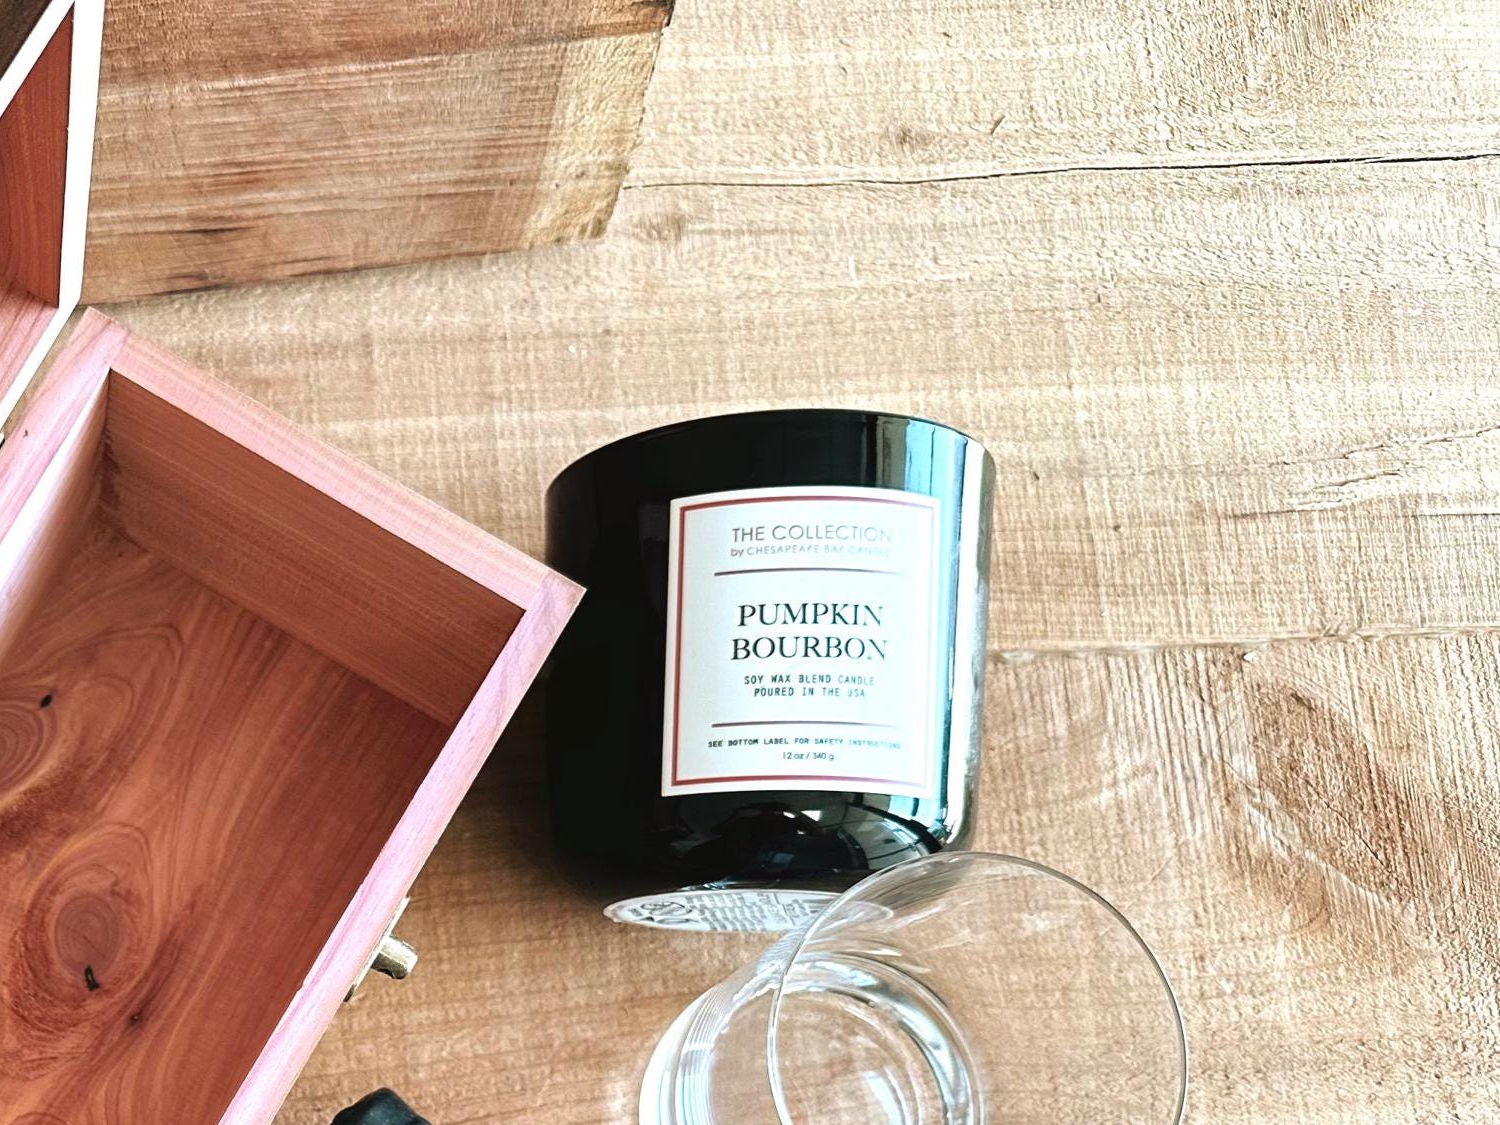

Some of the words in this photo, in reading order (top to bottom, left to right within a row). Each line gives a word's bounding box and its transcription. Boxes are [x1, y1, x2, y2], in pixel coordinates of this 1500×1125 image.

[732, 526, 765, 543] THE
[771, 524, 892, 542] COLLECTION
[730, 547, 744, 558] by
[746, 544, 820, 556] CHESAPEAKE
[737, 603, 884, 627] PUMPKIN
[730, 636, 888, 661] BOURBON
[744, 675, 764, 685] SOY
[770, 674, 791, 684] WAX
[798, 674, 832, 684] BLEND
[838, 675, 875, 686] CANDLE
[754, 687, 794, 697] POURED
[802, 687, 815, 696] IN
[822, 687, 841, 697] THE
[847, 688, 866, 697] USA
[727, 739, 759, 747] BOTTOM
[783, 752, 792, 760] 12
[812, 752, 827, 760] 340
